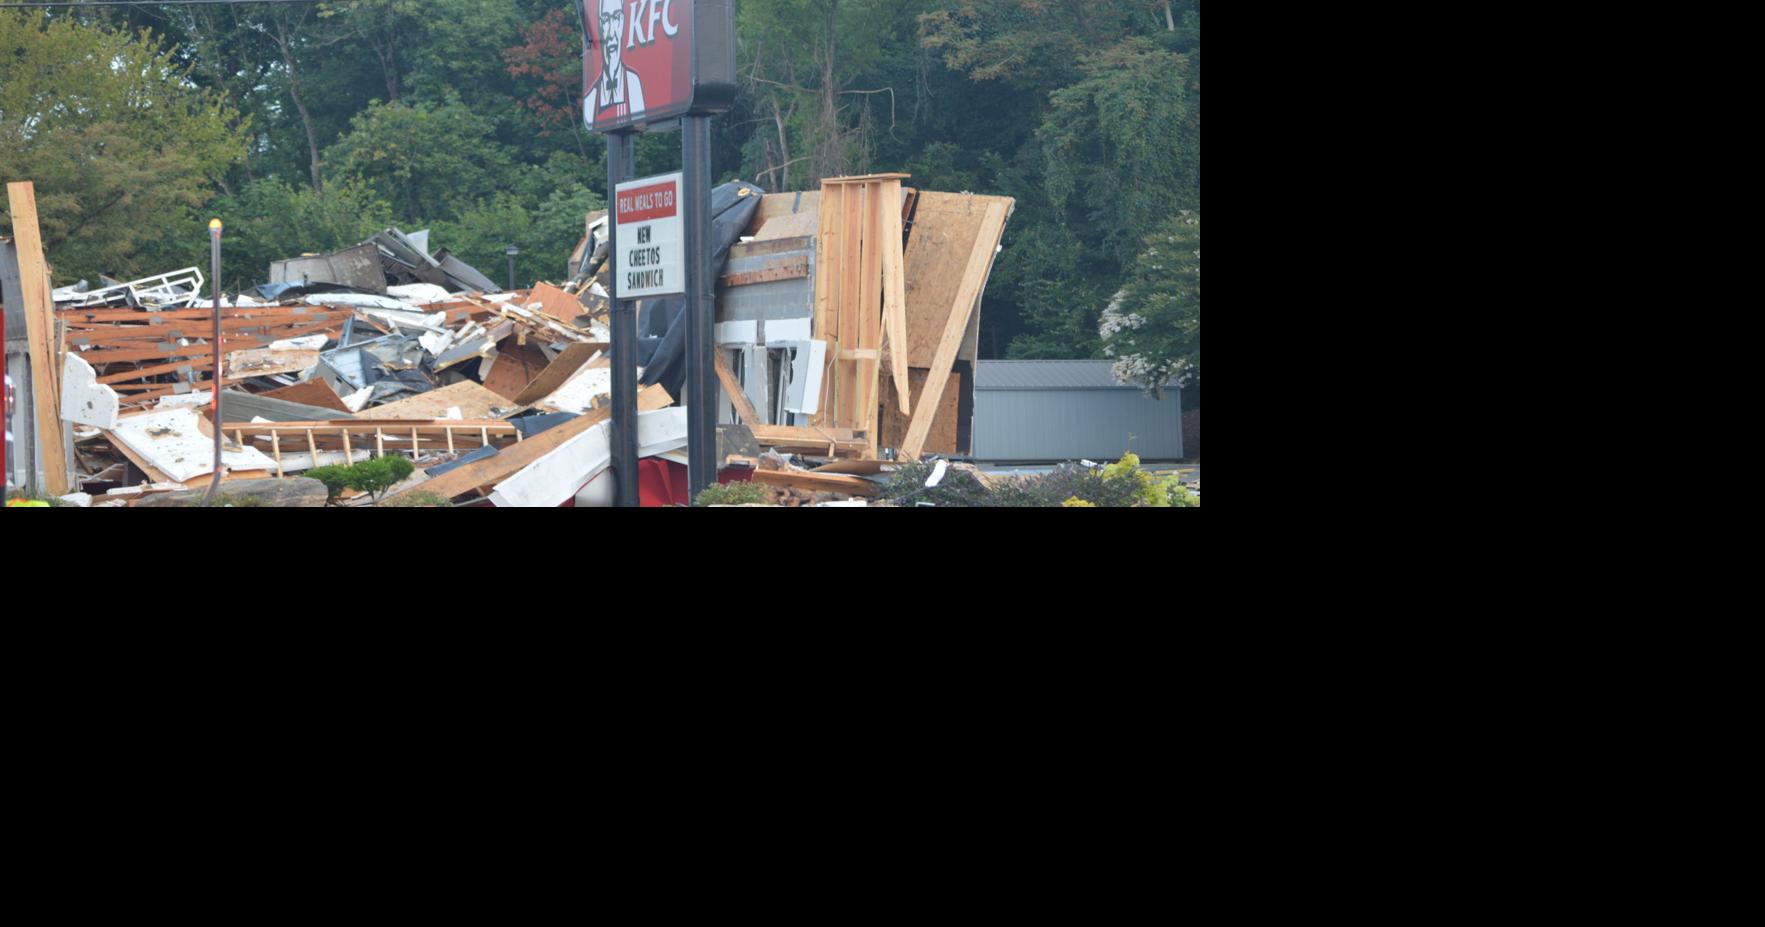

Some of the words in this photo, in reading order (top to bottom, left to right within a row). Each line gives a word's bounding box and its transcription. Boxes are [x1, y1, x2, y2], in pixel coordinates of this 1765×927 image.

[626, 0, 679, 49] KFC
[620, 197, 633, 213] REAL
[635, 194, 653, 211] MEALS
[655, 192, 662, 208] TO
[664, 190, 673, 207] GO
[637, 225, 651, 244] NEW
[629, 247, 660, 267] CHEETOS
[627, 269, 663, 290] SANDWICH
